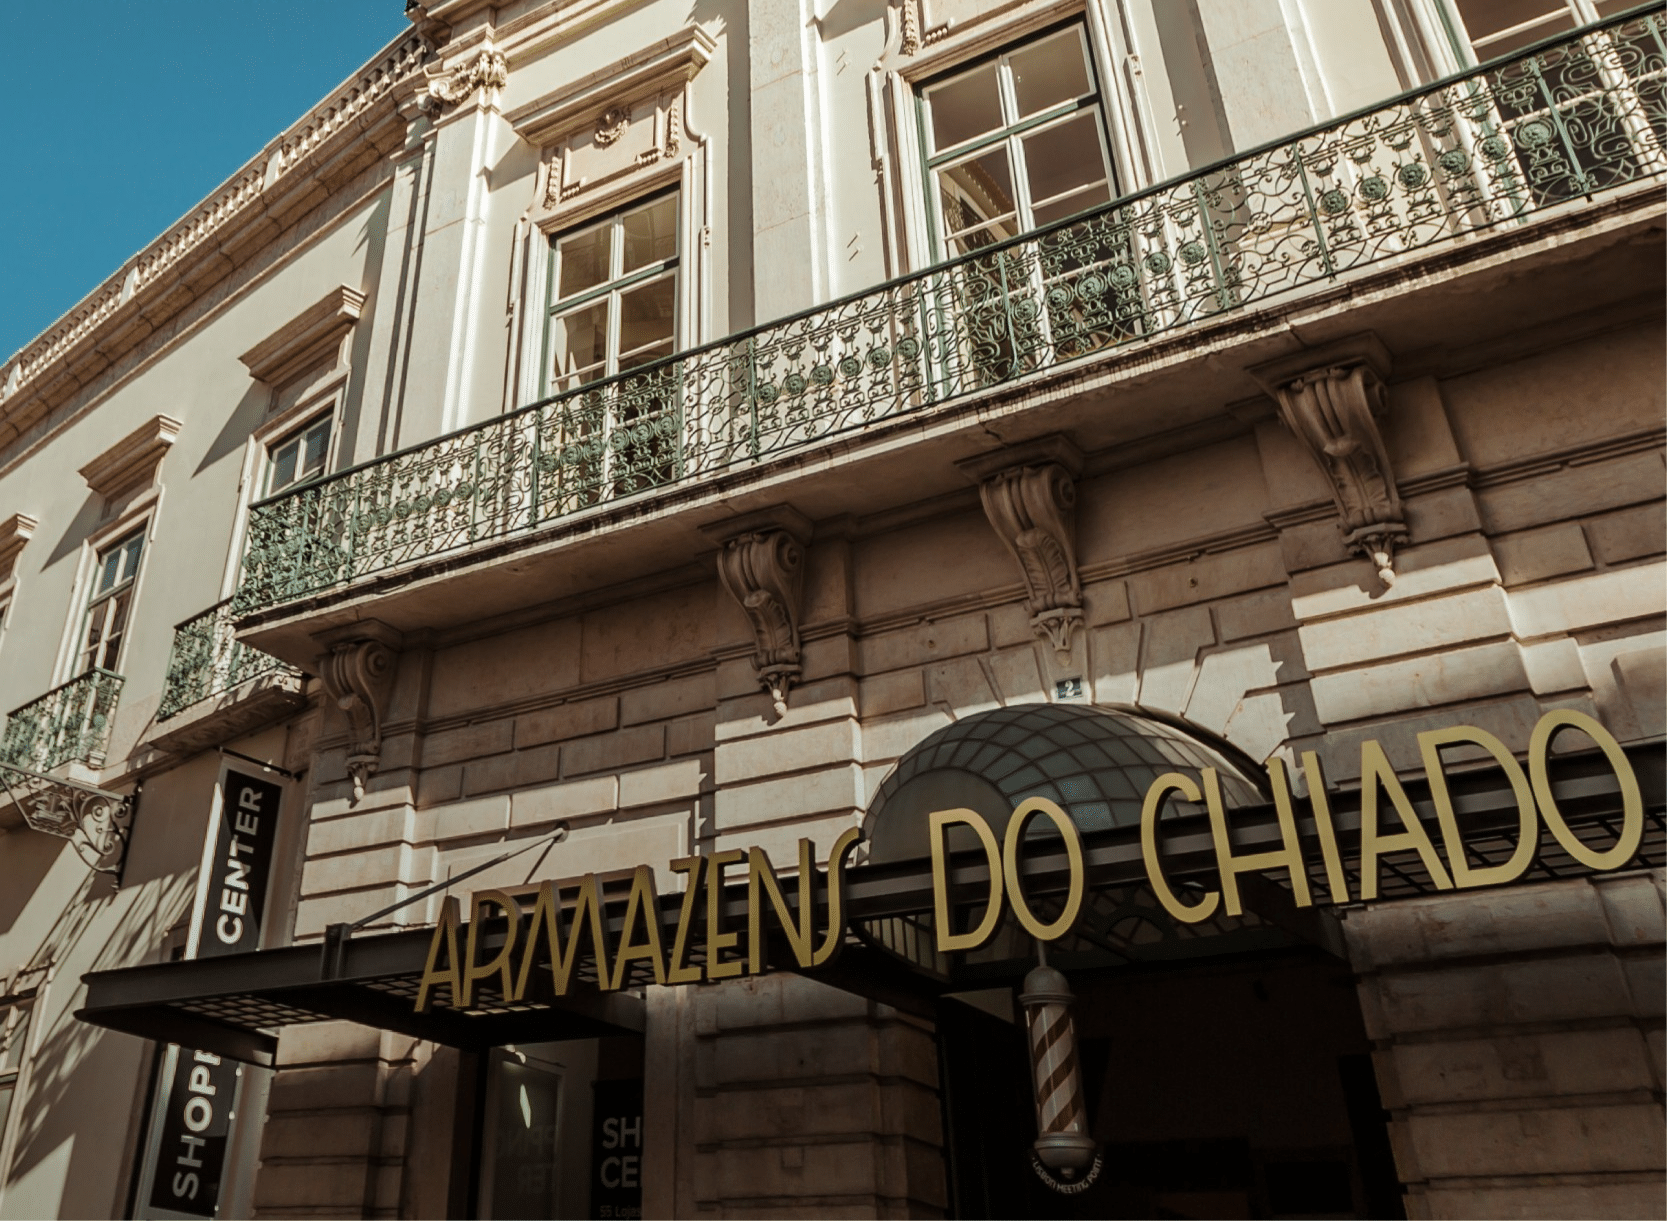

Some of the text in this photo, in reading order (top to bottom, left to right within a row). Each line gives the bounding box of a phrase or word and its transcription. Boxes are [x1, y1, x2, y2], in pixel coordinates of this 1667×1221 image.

[1065, 680, 1075, 697] 2
[216, 787, 264, 945] CENTER
[413, 709, 1645, 1014] ARMAZENS DO CHIADO
[600, 1156, 641, 1189] CE
[1032, 1157, 1102, 1194] LISBON MEETING POINT
